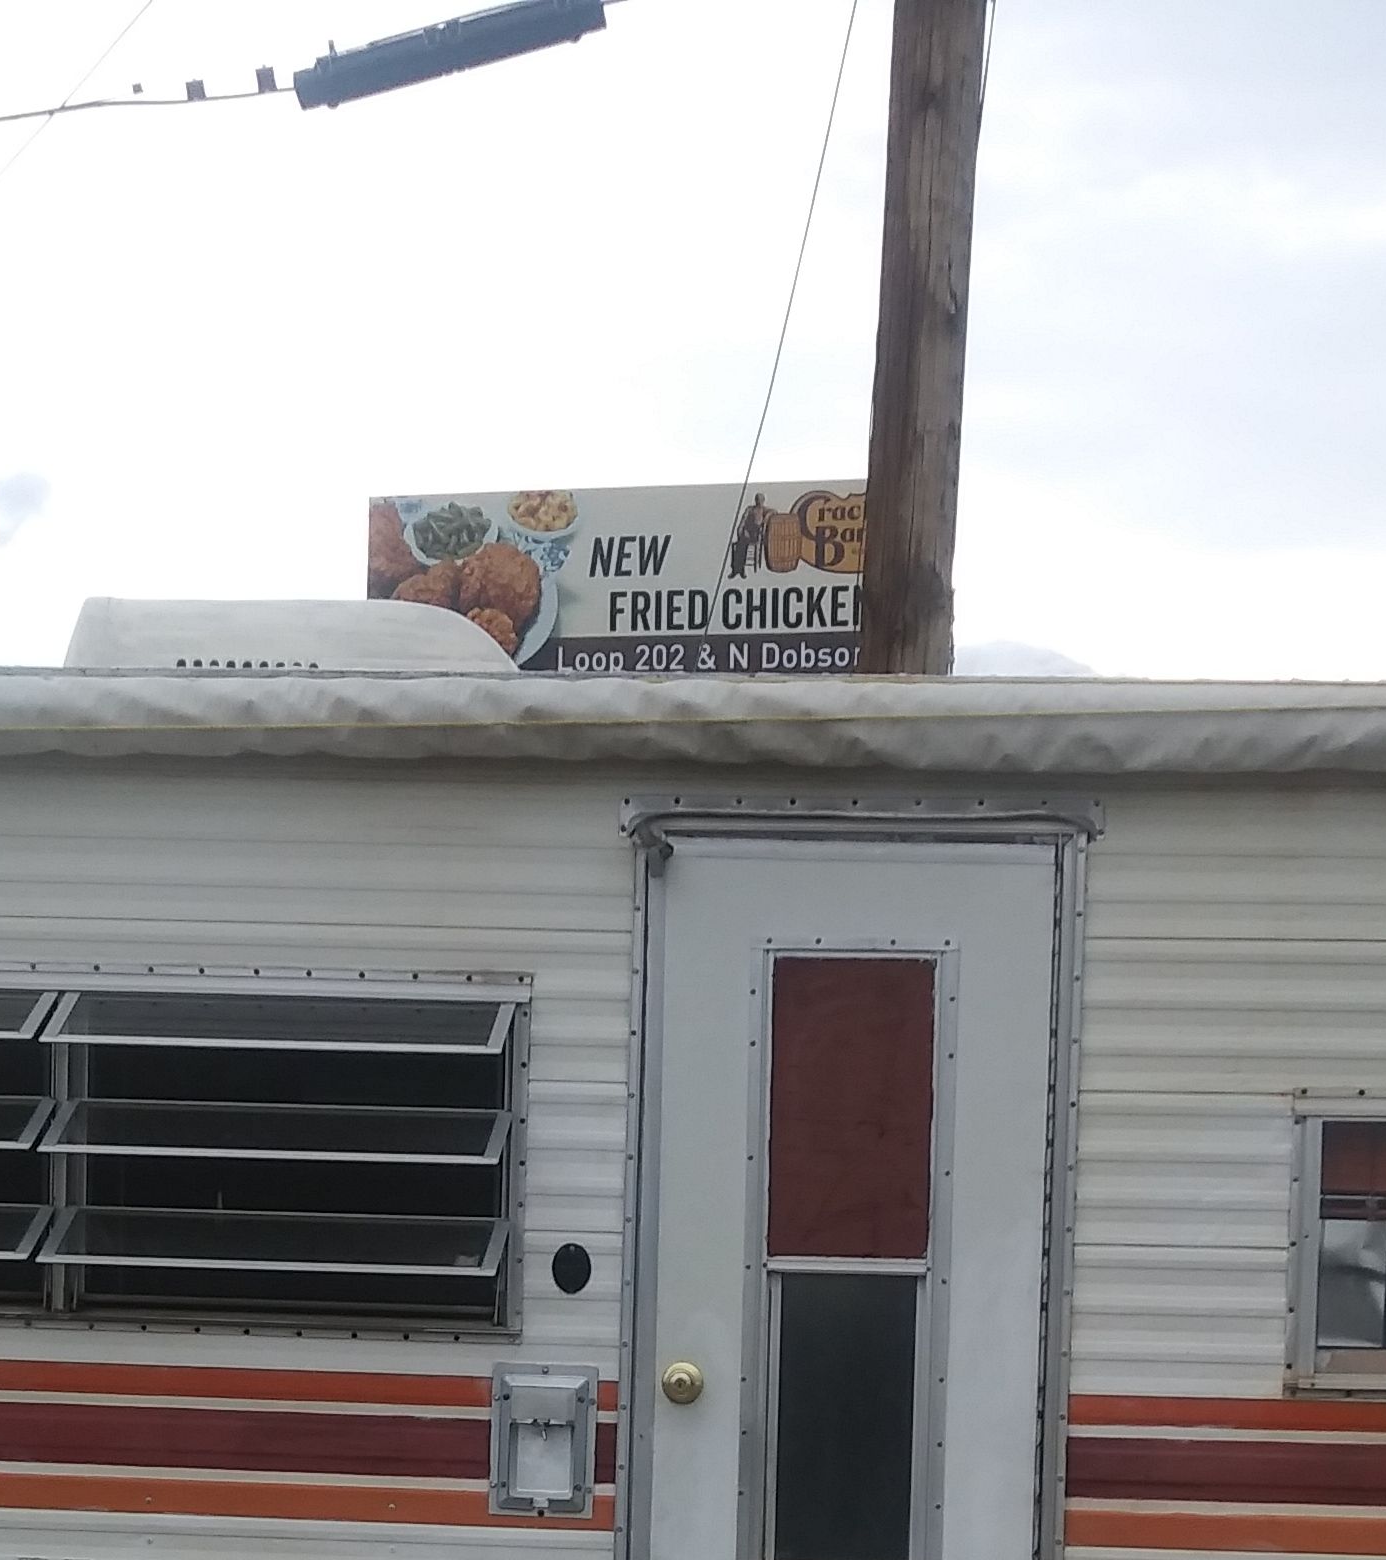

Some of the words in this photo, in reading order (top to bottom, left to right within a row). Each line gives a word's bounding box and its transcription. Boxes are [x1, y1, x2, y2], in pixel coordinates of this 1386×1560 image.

[589, 534, 672, 578] NEW
[609, 588, 710, 632] FRIED
[556, 645, 624, 673] Loop
[635, 643, 685, 671] 202
[697, 643, 717, 670] &
[729, 642, 749, 669] N
